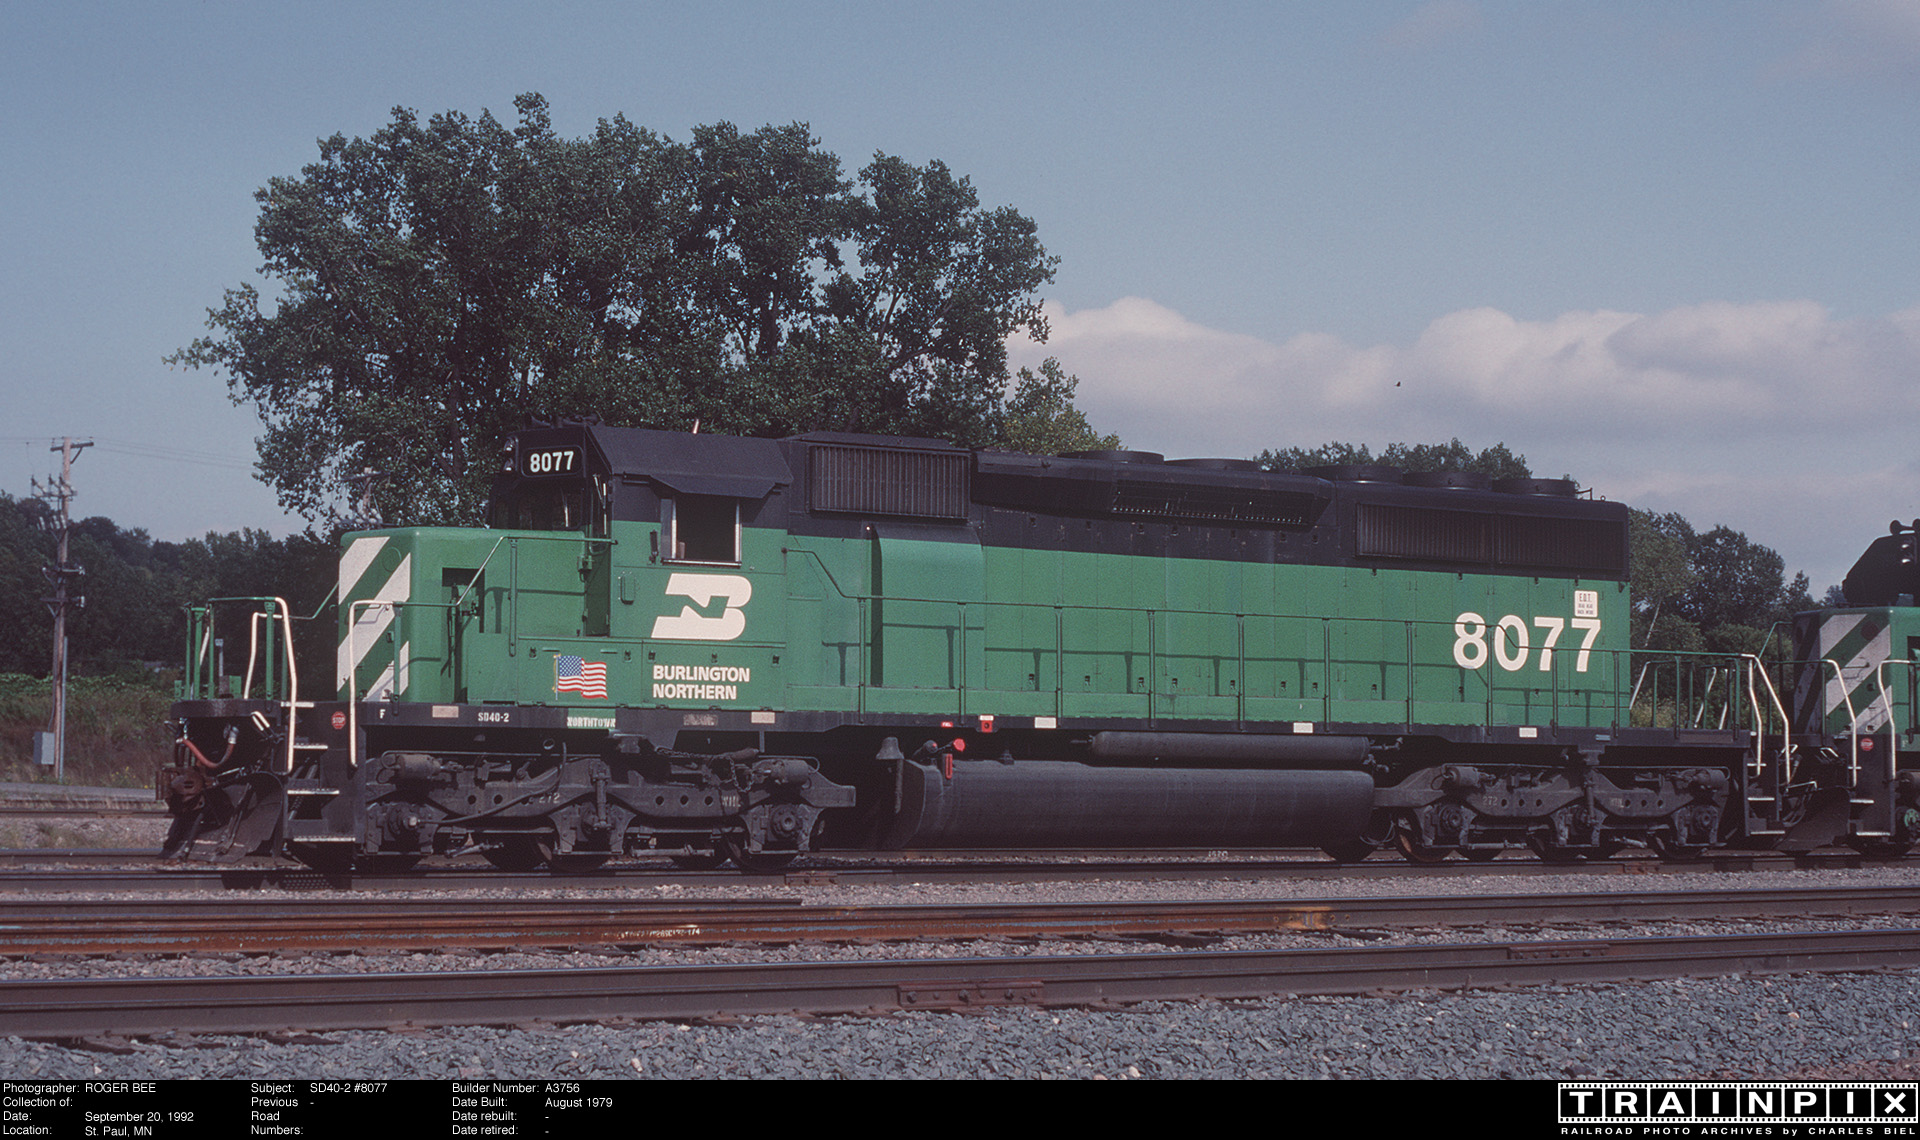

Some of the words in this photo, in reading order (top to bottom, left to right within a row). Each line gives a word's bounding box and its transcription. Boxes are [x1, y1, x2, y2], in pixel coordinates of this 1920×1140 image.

[530, 451, 574, 473] 8077
[1453, 612, 1601, 672] 8077
[653, 665, 750, 682] BURLINGTON
[653, 683, 737, 700] NORTHERN
[332, 716, 345, 724] STOP
[379, 709, 386, 719] F
[478, 712, 509, 722] SD40-2
[567, 716, 616, 727] NORTHTOWN
